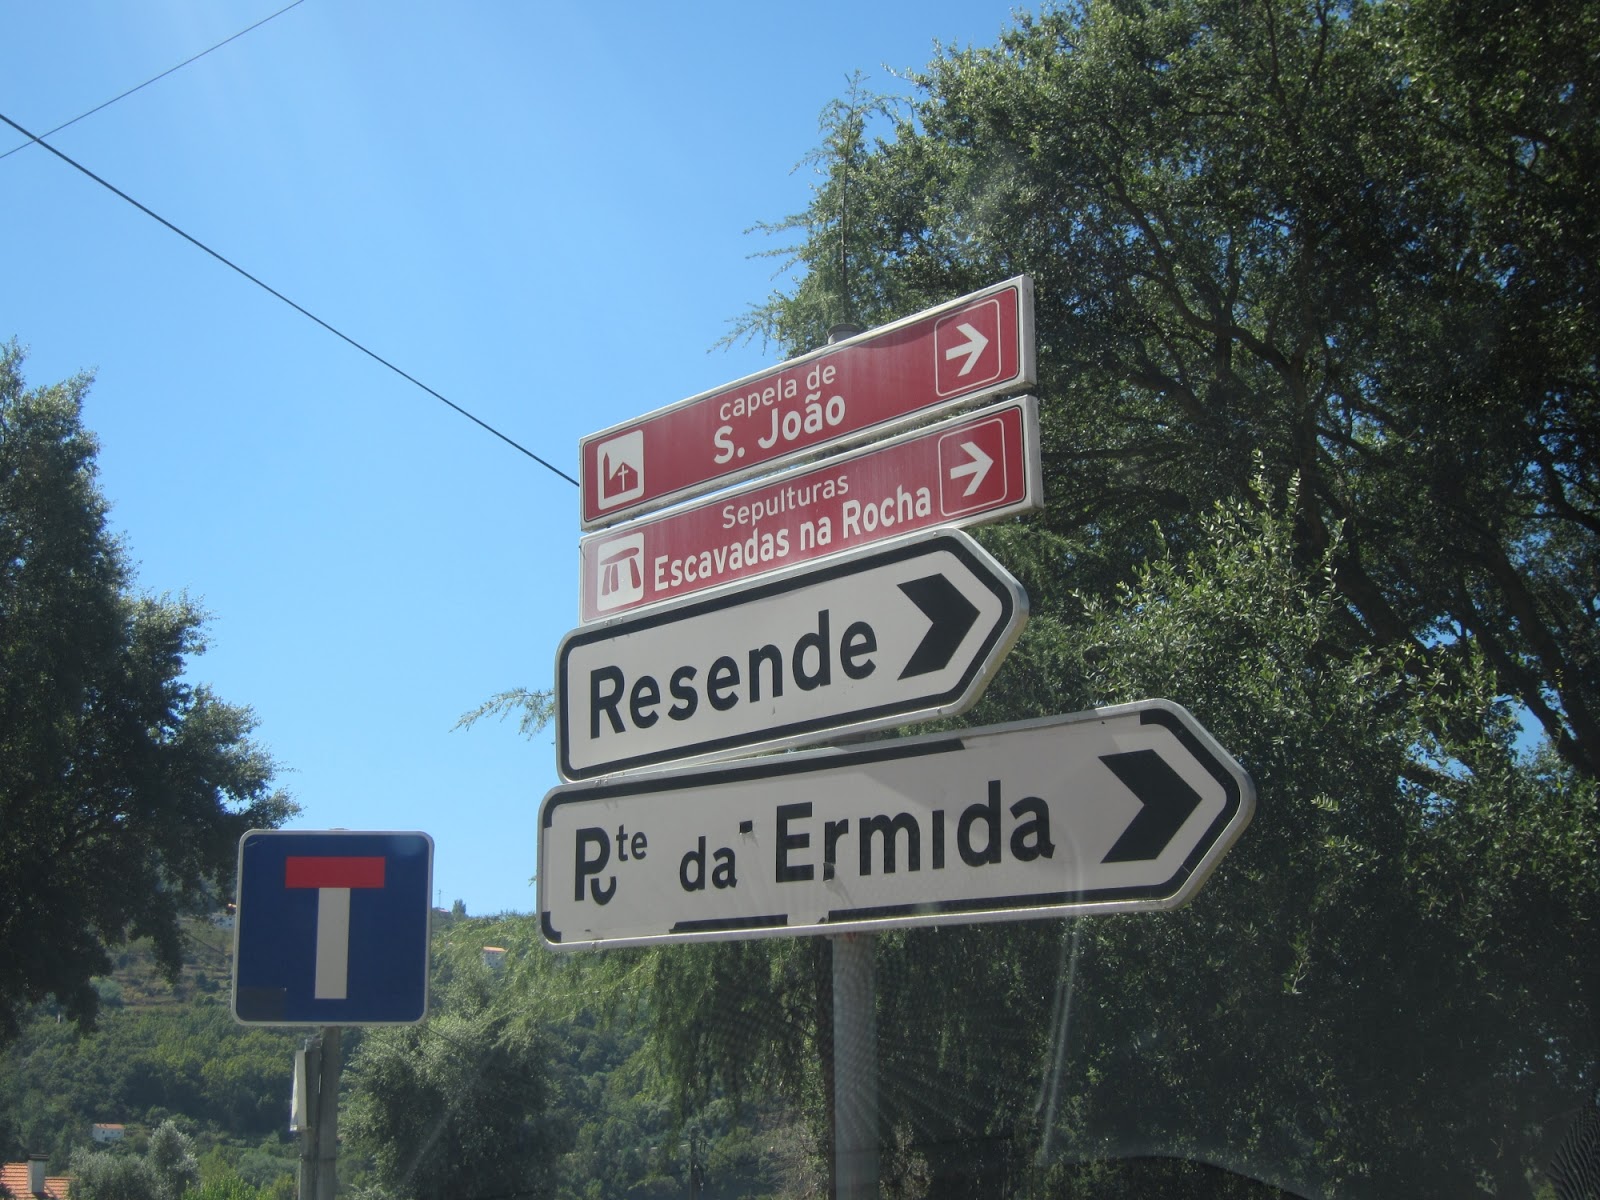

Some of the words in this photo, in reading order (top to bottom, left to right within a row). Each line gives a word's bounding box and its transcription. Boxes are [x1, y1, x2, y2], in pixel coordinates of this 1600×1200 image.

[719, 378, 798, 422] capela
[806, 363, 837, 392] de
[713, 426, 746, 465] S.
[758, 391, 846, 450] João
[722, 474, 849, 530] Sepulturas
[654, 528, 790, 592] Escavadas
[800, 515, 832, 552] na
[842, 484, 931, 540] Rocha
[589, 608, 878, 739] Resende
[678, 836, 738, 892] da
